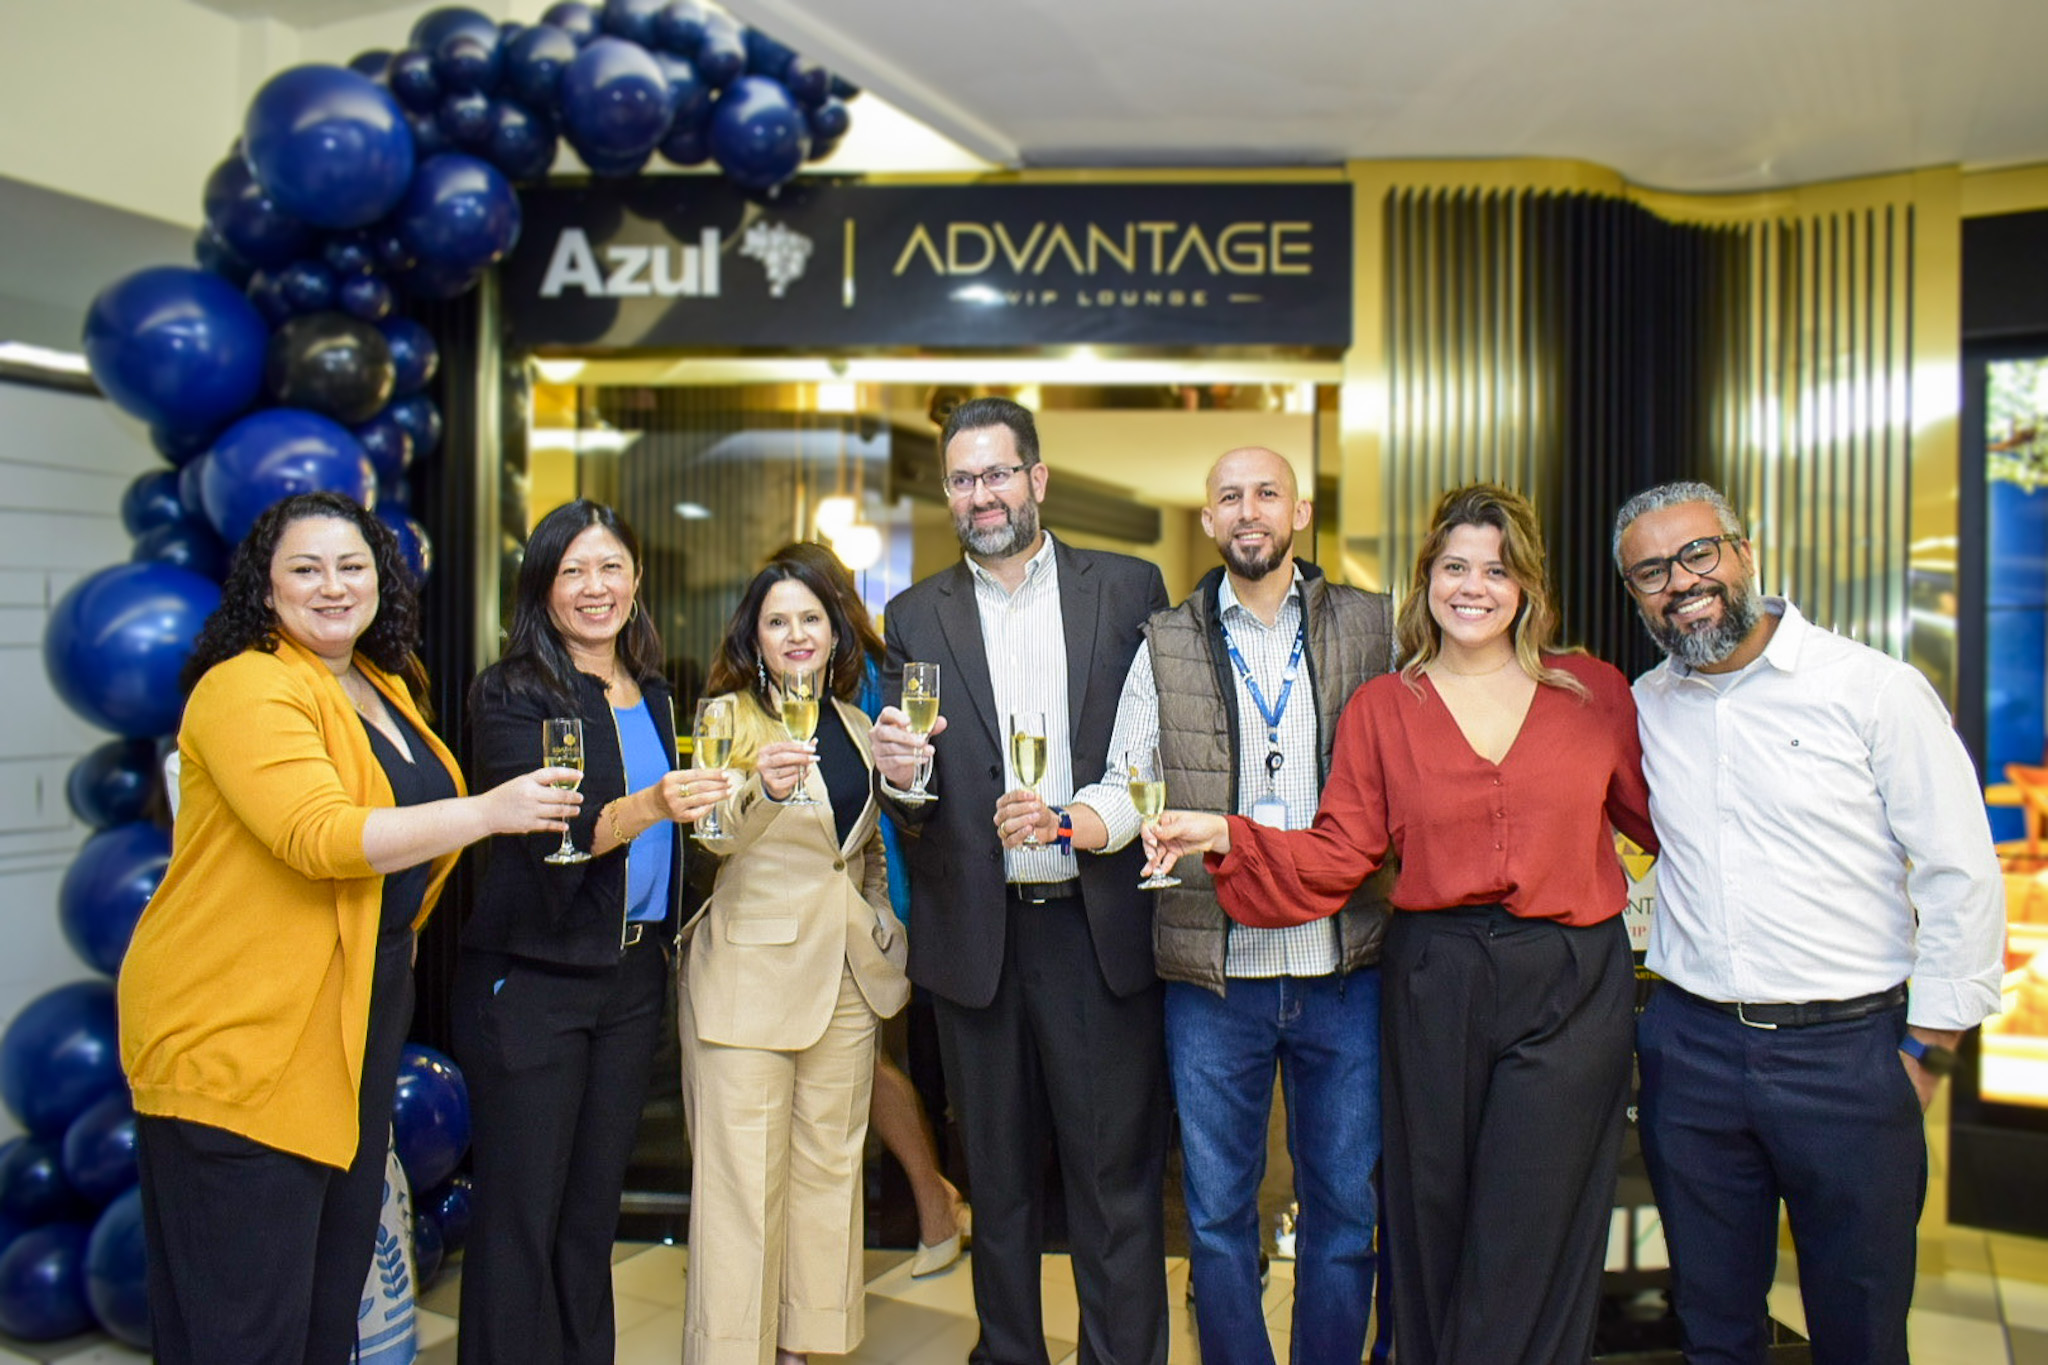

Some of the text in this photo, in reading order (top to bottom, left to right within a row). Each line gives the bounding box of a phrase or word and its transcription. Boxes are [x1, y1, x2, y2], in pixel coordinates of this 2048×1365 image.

[539, 227, 720, 297] Azul
[892, 222, 1312, 275] ADVANTAGE
[1005, 289, 1208, 307] VIP LOUNGE
